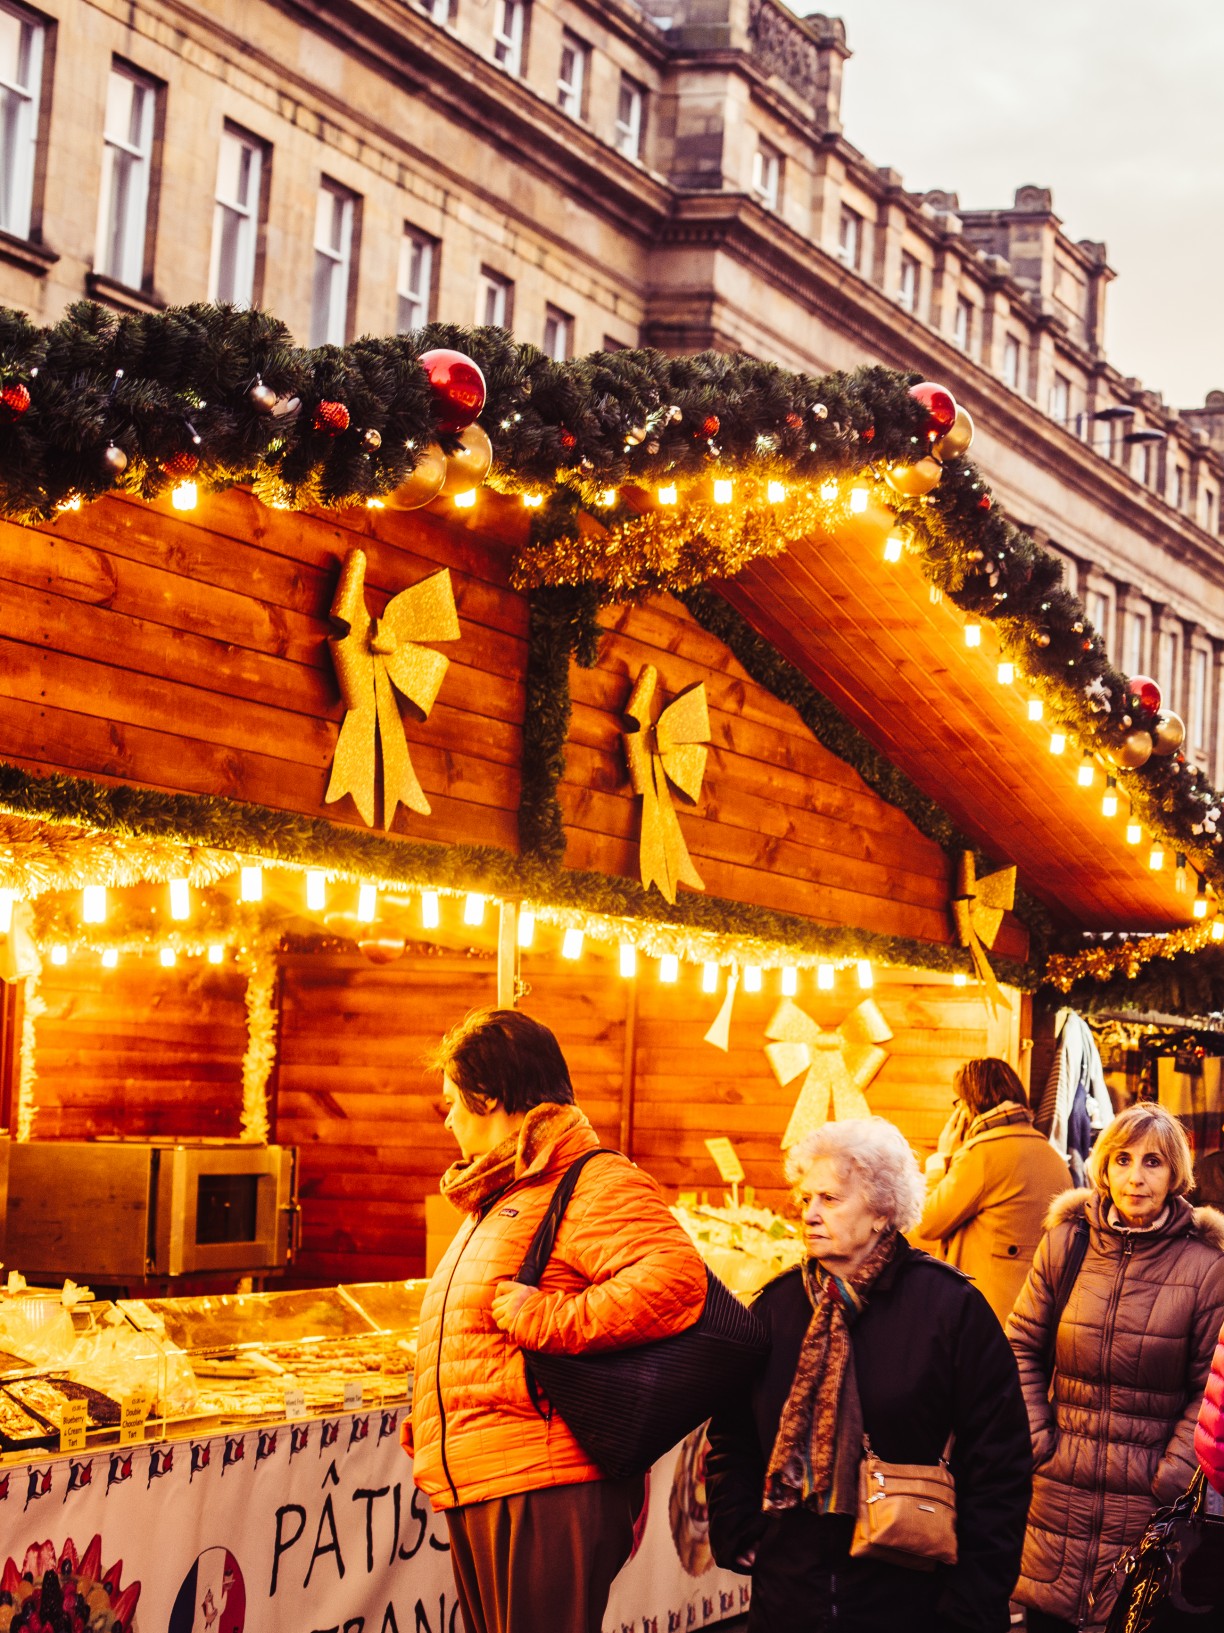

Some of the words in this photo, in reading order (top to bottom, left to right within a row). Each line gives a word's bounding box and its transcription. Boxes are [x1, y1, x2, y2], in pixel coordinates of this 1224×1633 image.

[126, 1408, 142, 1417] Double
[63, 1415, 84, 1425] Blueberry
[122, 1419, 143, 1429] Chocolate
[68, 1427, 82, 1436] Cream
[68, 1439, 78, 1447] Tart
